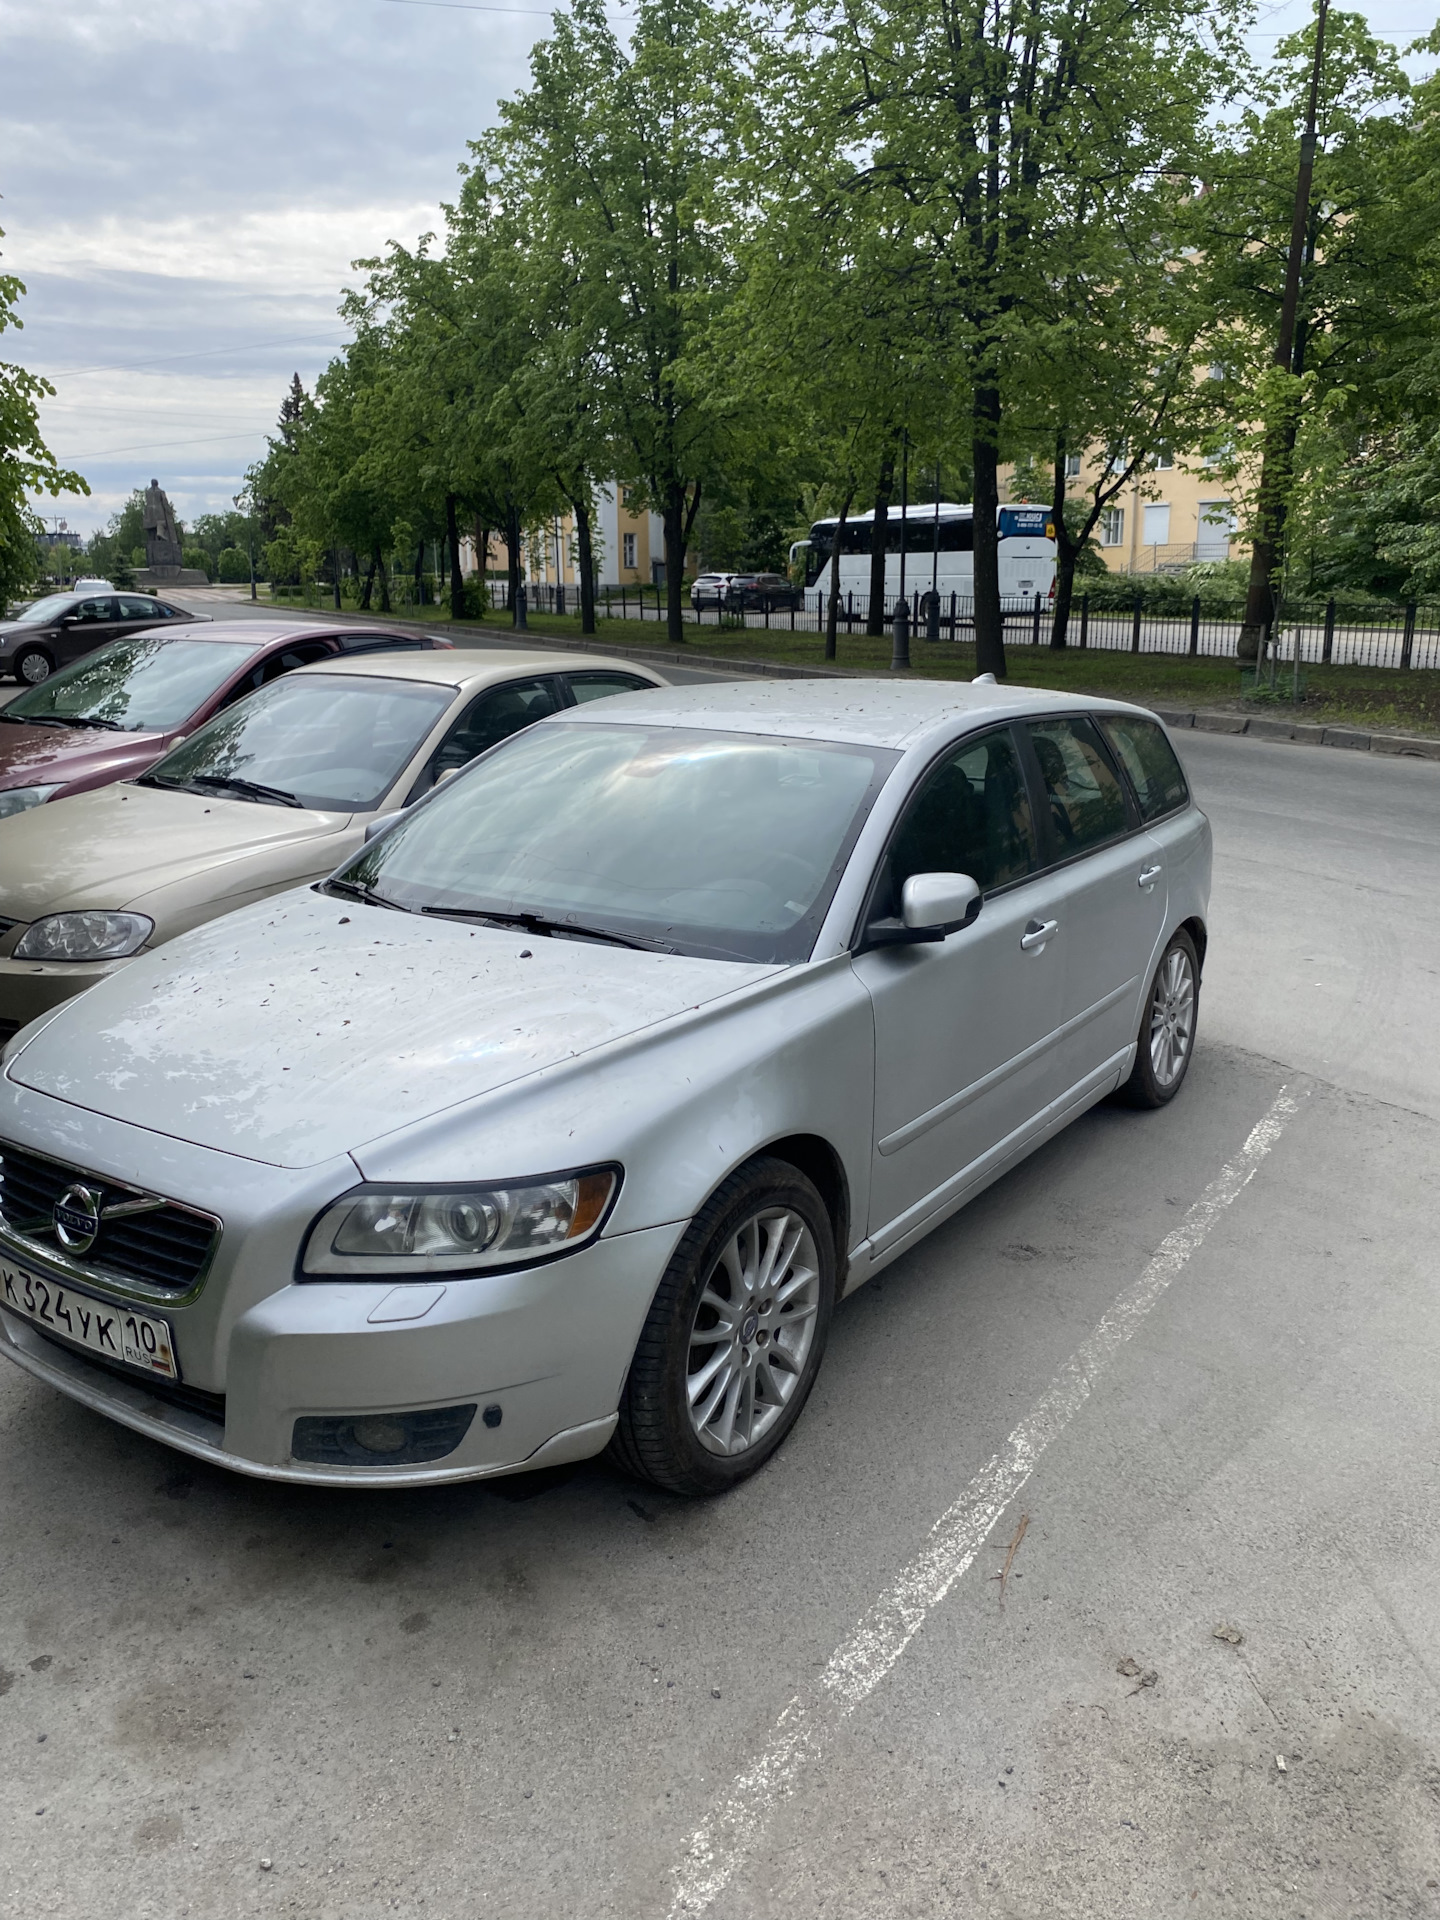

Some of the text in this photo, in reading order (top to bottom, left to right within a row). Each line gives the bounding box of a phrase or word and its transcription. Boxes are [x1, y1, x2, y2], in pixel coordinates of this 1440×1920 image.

[56, 1207, 93, 1231] VOLVO
[126, 1316, 156, 1353] 10
[125, 1346, 150, 1364] RUS
